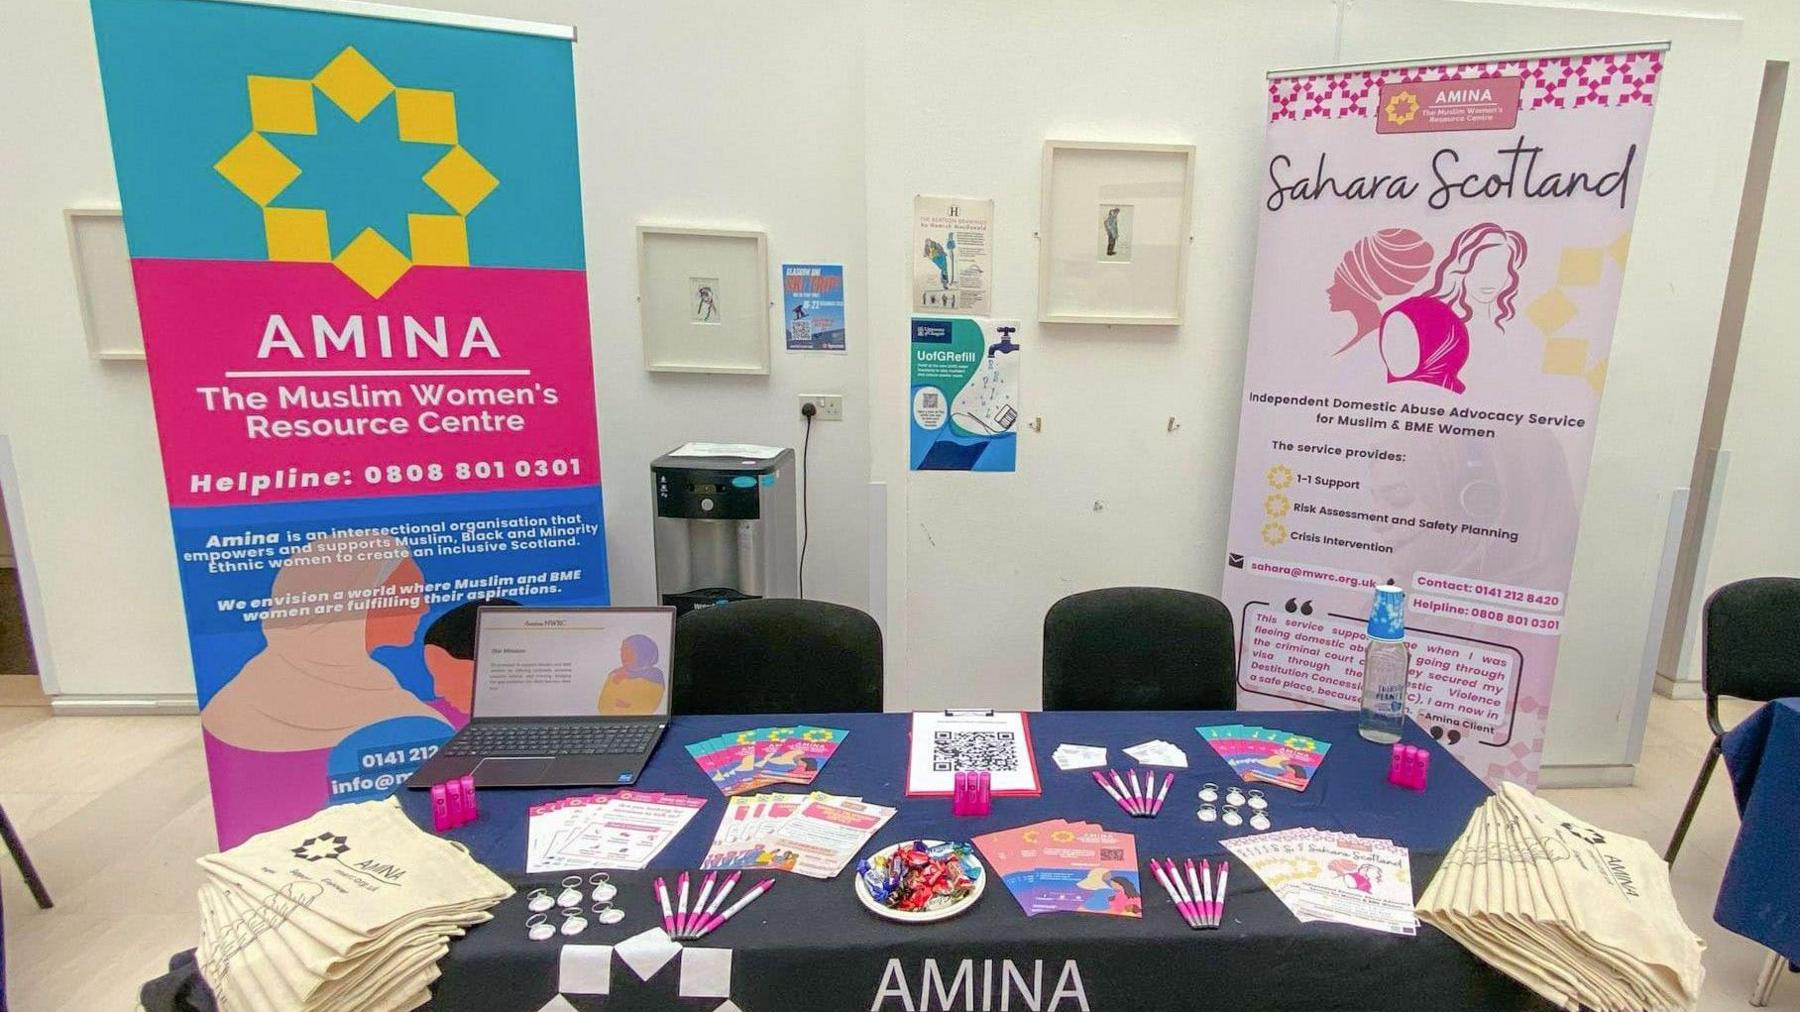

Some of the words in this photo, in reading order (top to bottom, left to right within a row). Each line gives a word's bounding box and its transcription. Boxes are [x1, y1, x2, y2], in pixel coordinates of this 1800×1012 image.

[1436, 88, 1492, 104] AMINA
[1438, 108, 1464, 116] Muslim
[1467, 114, 1494, 122] Centre
[1266, 152, 1419, 212] Sahara
[1428, 135, 1636, 209] Scotland
[256, 313, 501, 360] AMINA
[917, 350, 976, 363] UofGRefill
[197, 387, 268, 411] The
[279, 384, 401, 410] Muslim
[411, 382, 559, 407] Women's
[1249, 392, 1329, 407] Independent
[1333, 398, 1397, 413] Domestic
[1400, 403, 1445, 416] Abuse
[1449, 407, 1524, 426] Advocacy
[1528, 413, 1586, 428] Service
[247, 413, 409, 440] Resource
[419, 410, 525, 434] Centre
[1316, 413, 1334, 424] for
[1337, 415, 1387, 429] Muslim
[1391, 420, 1400, 430] &
[1404, 421, 1434, 433] BME
[1438, 423, 1496, 438] Women
[1272, 440, 1294, 451] The
[1297, 443, 1342, 456] service
[1346, 447, 1407, 462] provides:
[190, 467, 353, 497] Helpline:
[365, 463, 443, 486] 0808
[455, 461, 505, 481] 801
[514, 457, 581, 478] 0301
[1297, 474, 1312, 484] 1-1
[1314, 476, 1360, 490] Support
[206, 531, 280, 549] Amina
[286, 530, 302, 542] is
[306, 530, 328, 542] an
[332, 521, 445, 540] intersectional
[450, 516, 547, 534] organisation
[552, 514, 582, 526] that
[1294, 503, 1316, 514] Risk
[1320, 506, 1389, 524] Assessment
[1392, 515, 1416, 526] and
[1418, 518, 1458, 534] Safety
[1461, 524, 1519, 543] Planning
[184, 546, 275, 565] empowers
[279, 542, 312, 556] and
[316, 537, 391, 554] supports
[395, 532, 458, 547] Muslim,
[462, 528, 504, 542] Black
[508, 526, 536, 539] and
[540, 523, 598, 538] Minority
[209, 559, 264, 574] Ethnic
[269, 554, 332, 569] women
[336, 552, 352, 563] to
[357, 548, 410, 562] create
[414, 546, 434, 558] an
[438, 542, 507, 556] inclusive
[511, 538, 580, 551] Scotland.
[1290, 531, 1320, 543] Crisis
[1323, 535, 1394, 554] Intervention
[218, 598, 246, 612] We
[250, 592, 329, 608] envision
[333, 590, 344, 600] a
[348, 584, 396, 600] world
[400, 581, 450, 596] where
[454, 574, 514, 590] Muslim
[516, 571, 548, 585] and
[550, 570, 582, 581] BME
[1251, 562, 1377, 589] sahara@mwrc.org.uk
[1417, 576, 1473, 593] Contact:
[1475, 585, 1501, 598] 0141
[1504, 590, 1524, 602] 212
[1526, 594, 1560, 606] 8420
[243, 605, 310, 623] women
[314, 603, 344, 615] are
[348, 595, 420, 612] fulfilling
[424, 592, 464, 605] their
[467, 585, 562, 602] aspirations.
[1413, 598, 1469, 616] Helpline:
[1471, 608, 1504, 622] 0808
[1506, 614, 1528, 626] 801
[1531, 618, 1560, 630] 0301
[1254, 626, 1291, 640] fleeing
[1294, 633, 1346, 649] domestic
[1416, 657, 1451, 671] going
[1456, 663, 1505, 681] through
[1256, 614, 1278, 624] This
[1285, 620, 1324, 632] service
[1427, 645, 1460, 657] when
[1482, 656, 1507, 667] was
[1252, 650, 1274, 660] visa
[1288, 656, 1331, 672] through
[1344, 668, 1363, 678] the
[1449, 688, 1502, 706] Violence
[1254, 638, 1270, 647] the
[1275, 642, 1321, 656] criminal
[1325, 652, 1354, 663] court
[1428, 672, 1478, 688] secured
[1482, 684, 1504, 696] my
[1251, 661, 1310, 679] Destitution
[1311, 673, 1362, 691] Concessi
[1434, 700, 1455, 710] am
[1458, 704, 1484, 717] now
[1486, 709, 1499, 720] in
[1259, 675, 1281, 686] safe
[1282, 680, 1316, 694] place,
[1420, 712, 1460, 726] -Amina
[1462, 720, 1496, 735] Client
[362, 750, 406, 768] 0141
[409, 745, 439, 762] 212
[354, 859, 406, 882] AMINA
[1604, 854, 1640, 898] AMINA
[870, 958, 1091, 1012] AMINA
